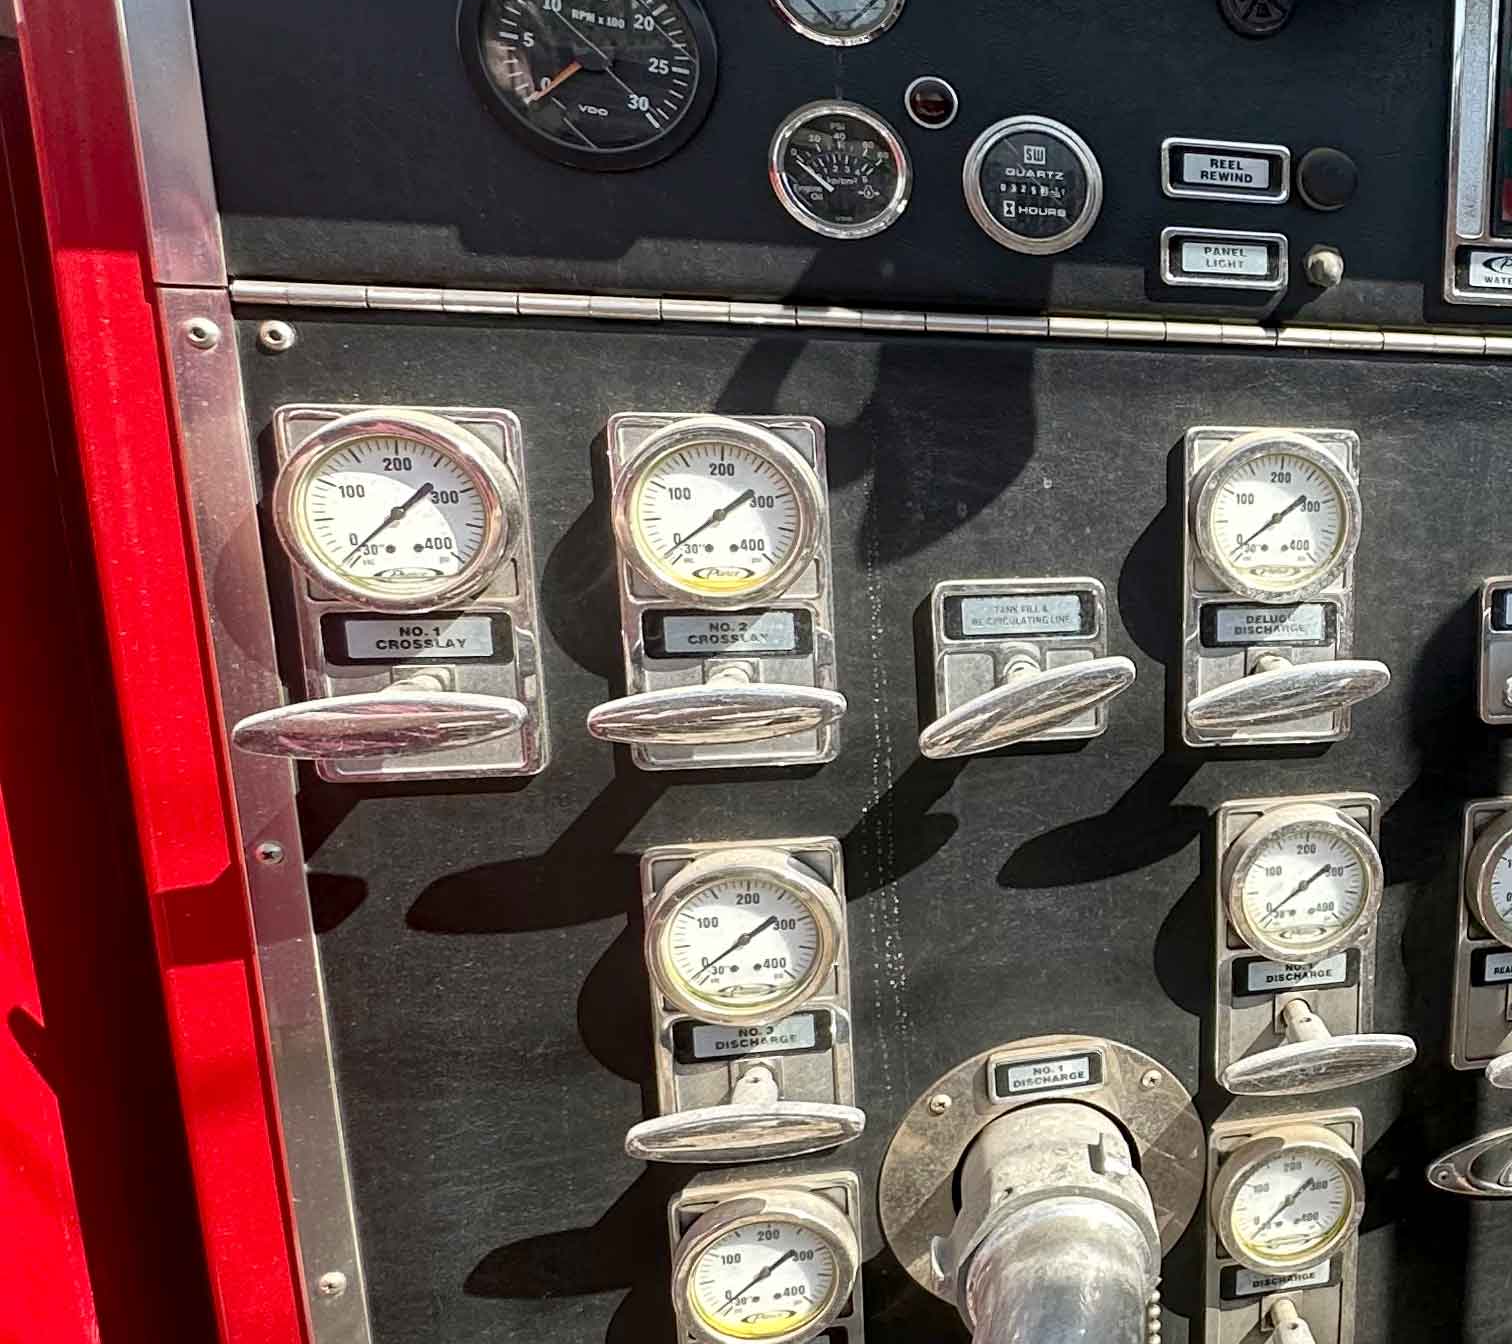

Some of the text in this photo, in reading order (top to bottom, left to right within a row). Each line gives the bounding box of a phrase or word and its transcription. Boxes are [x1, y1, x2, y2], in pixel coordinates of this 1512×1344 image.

[571, 9, 595, 24] RPM
[633, 14, 655, 31] 20
[522, 32, 534, 48] 5
[648, 58, 669, 74] 25
[628, 94, 650, 111] 30
[577, 104, 608, 117] VDO
[1209, 158, 1244, 170] REEL
[1005, 168, 1064, 180] QUARTZ
[1200, 170, 1253, 183] REWIND
[1018, 206, 1066, 217] HOURS
[1203, 247, 1247, 257] PANEL
[1205, 258, 1245, 268] LIGHT
[383, 457, 412, 471] 200
[709, 463, 735, 476] 200
[1271, 472, 1292, 483] 200
[338, 484, 365, 498] 100
[432, 490, 460, 504] 300
[668, 487, 691, 500] 100
[750, 495, 774, 508] 300
[1236, 493, 1254, 505] 100
[1301, 500, 1320, 512] 300
[349, 533, 358, 546] 0
[424, 537, 453, 550] 400
[673, 532, 681, 544] 0
[1236, 534, 1243, 545] 0
[740, 538, 765, 552] 400
[1289, 540, 1310, 551] 400
[994, 606, 1019, 614] TANK
[399, 627, 440, 637] NO. 1
[709, 622, 748, 632] NO. 2
[1234, 625, 1305, 635] DISCHARGE
[376, 638, 467, 650] CROSSLAY
[688, 633, 769, 645] CROSSLAY
[1296, 843, 1317, 855] 200
[1265, 866, 1282, 876] 100
[736, 893, 761, 905] 200
[1506, 892, 1512, 902] 0
[697, 917, 719, 929] 100
[773, 919, 796, 931] 300
[701, 957, 709, 970] 0
[763, 958, 787, 969] 400
[1266, 969, 1333, 983] DISCHARGE
[738, 1026, 764, 1038] NO.
[715, 1035, 798, 1050] DISCHARGE
[1033, 1066, 1055, 1074] NO.
[1013, 1071, 1084, 1088] DISCHARGE
[757, 1230, 780, 1241] 200
[721, 1254, 741, 1265] 100
[1252, 1272, 1315, 1288] DISCHARGE
[725, 1290, 732, 1300] 0
[783, 1285, 805, 1297] 400
